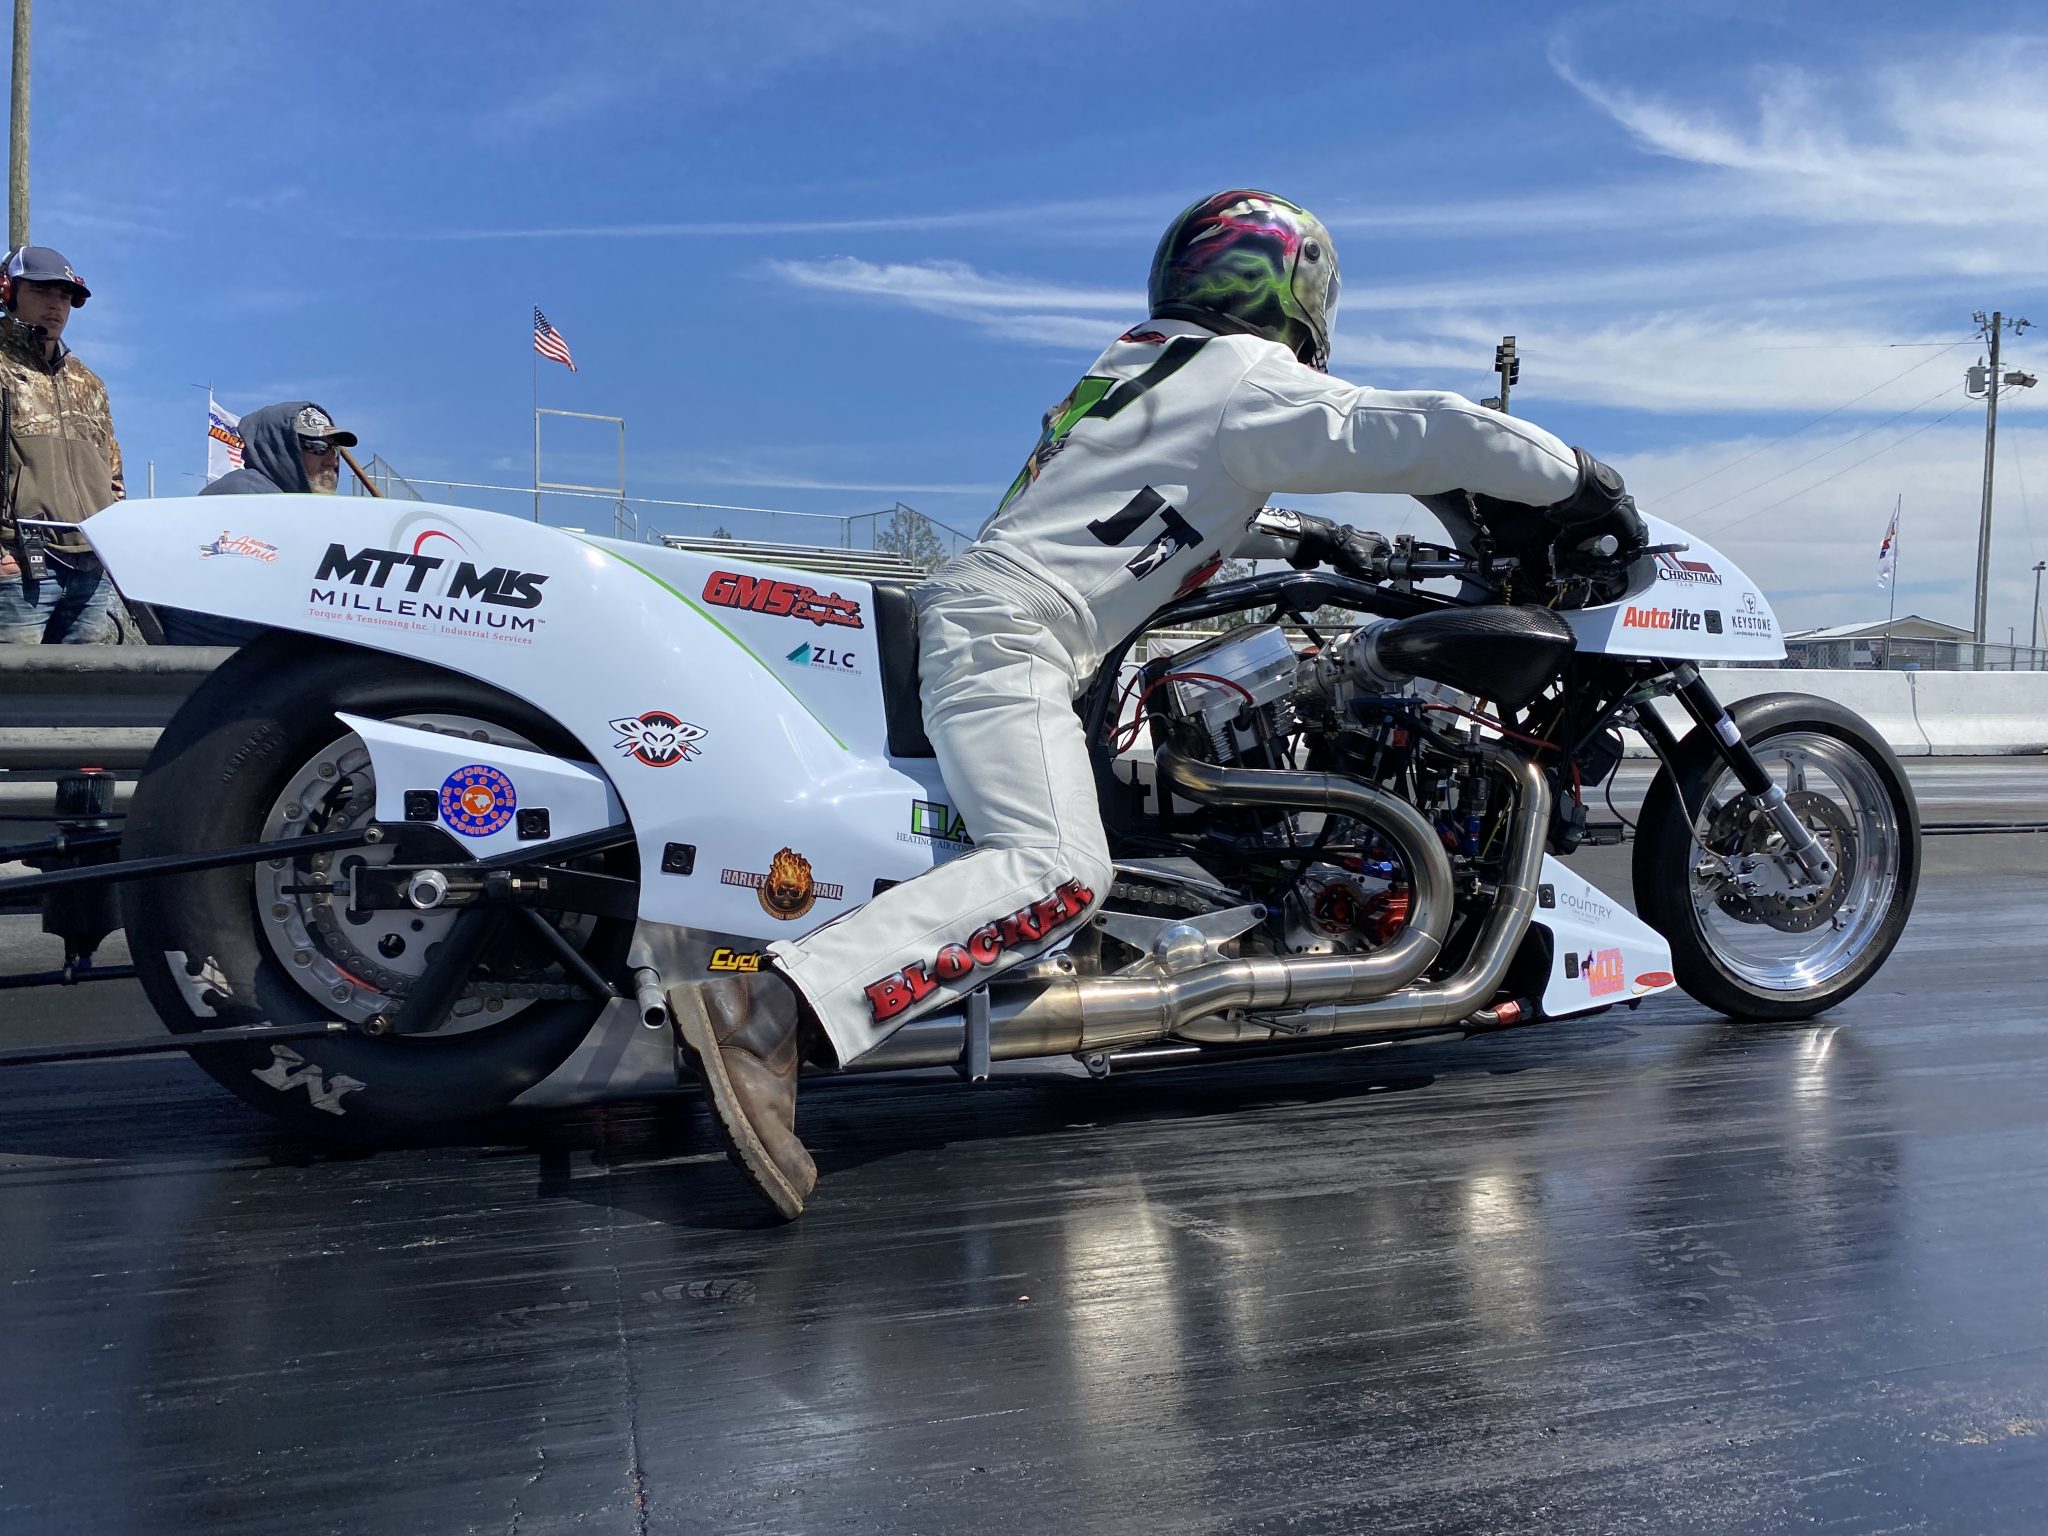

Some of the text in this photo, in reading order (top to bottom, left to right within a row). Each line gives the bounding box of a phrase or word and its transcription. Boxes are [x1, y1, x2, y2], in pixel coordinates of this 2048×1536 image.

[314, 543, 550, 610] MTT MIS
[1659, 568, 1723, 586] CHRISTMAN
[702, 570, 797, 618] GMS
[309, 608, 533, 645] Torque & Tensioning Inc. Industrial Services
[1622, 606, 1700, 631] Autolite
[1731, 615, 1772, 631] KEYSTONE
[811, 646, 857, 669] ZLC
[896, 831, 932, 847] HEATING
[938, 840, 951, 850] AIR
[722, 869, 844, 901] HARLEY HAUL
[1560, 893, 1612, 920] COUNTRY
[709, 949, 760, 972] Cycl
[863, 876, 1094, 1024] BLOCKER
